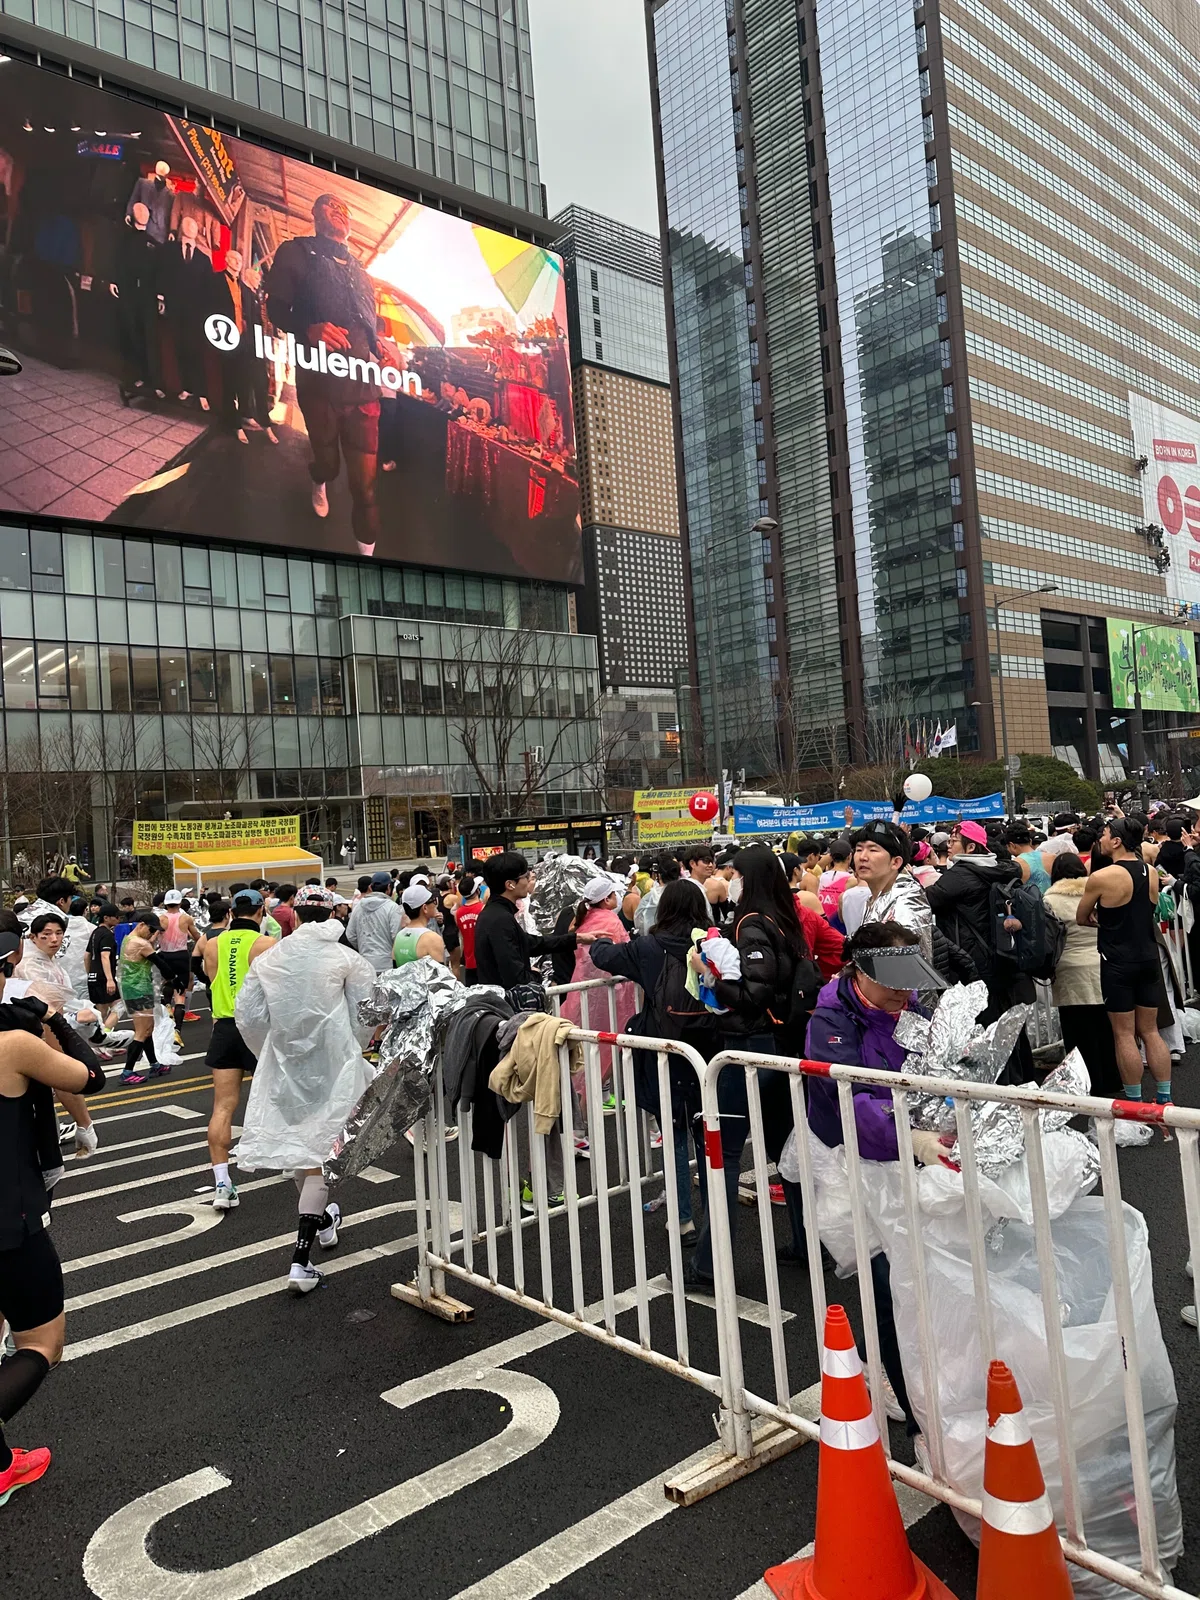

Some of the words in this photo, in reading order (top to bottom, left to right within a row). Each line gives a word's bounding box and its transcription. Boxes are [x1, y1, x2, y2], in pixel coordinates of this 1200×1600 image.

[253, 323, 422, 396] lululemon
[1155, 444, 1170, 457] BORN
[1170, 446, 1177, 457] IN
[1178, 447, 1196, 460] KOREA
[137, 823, 157, 831] 헌법에
[159, 823, 178, 831] 보장된
[180, 822, 203, 831] 노동3권
[640, 821, 654, 831] Stop
[654, 820, 670, 829] Killing
[756, 818, 780, 828] 여러분의
[137, 832, 164, 841] 국정원의
[640, 831, 661, 840] Support
[661, 829, 688, 838] Liberation
[228, 947, 238, 987] BANANA
